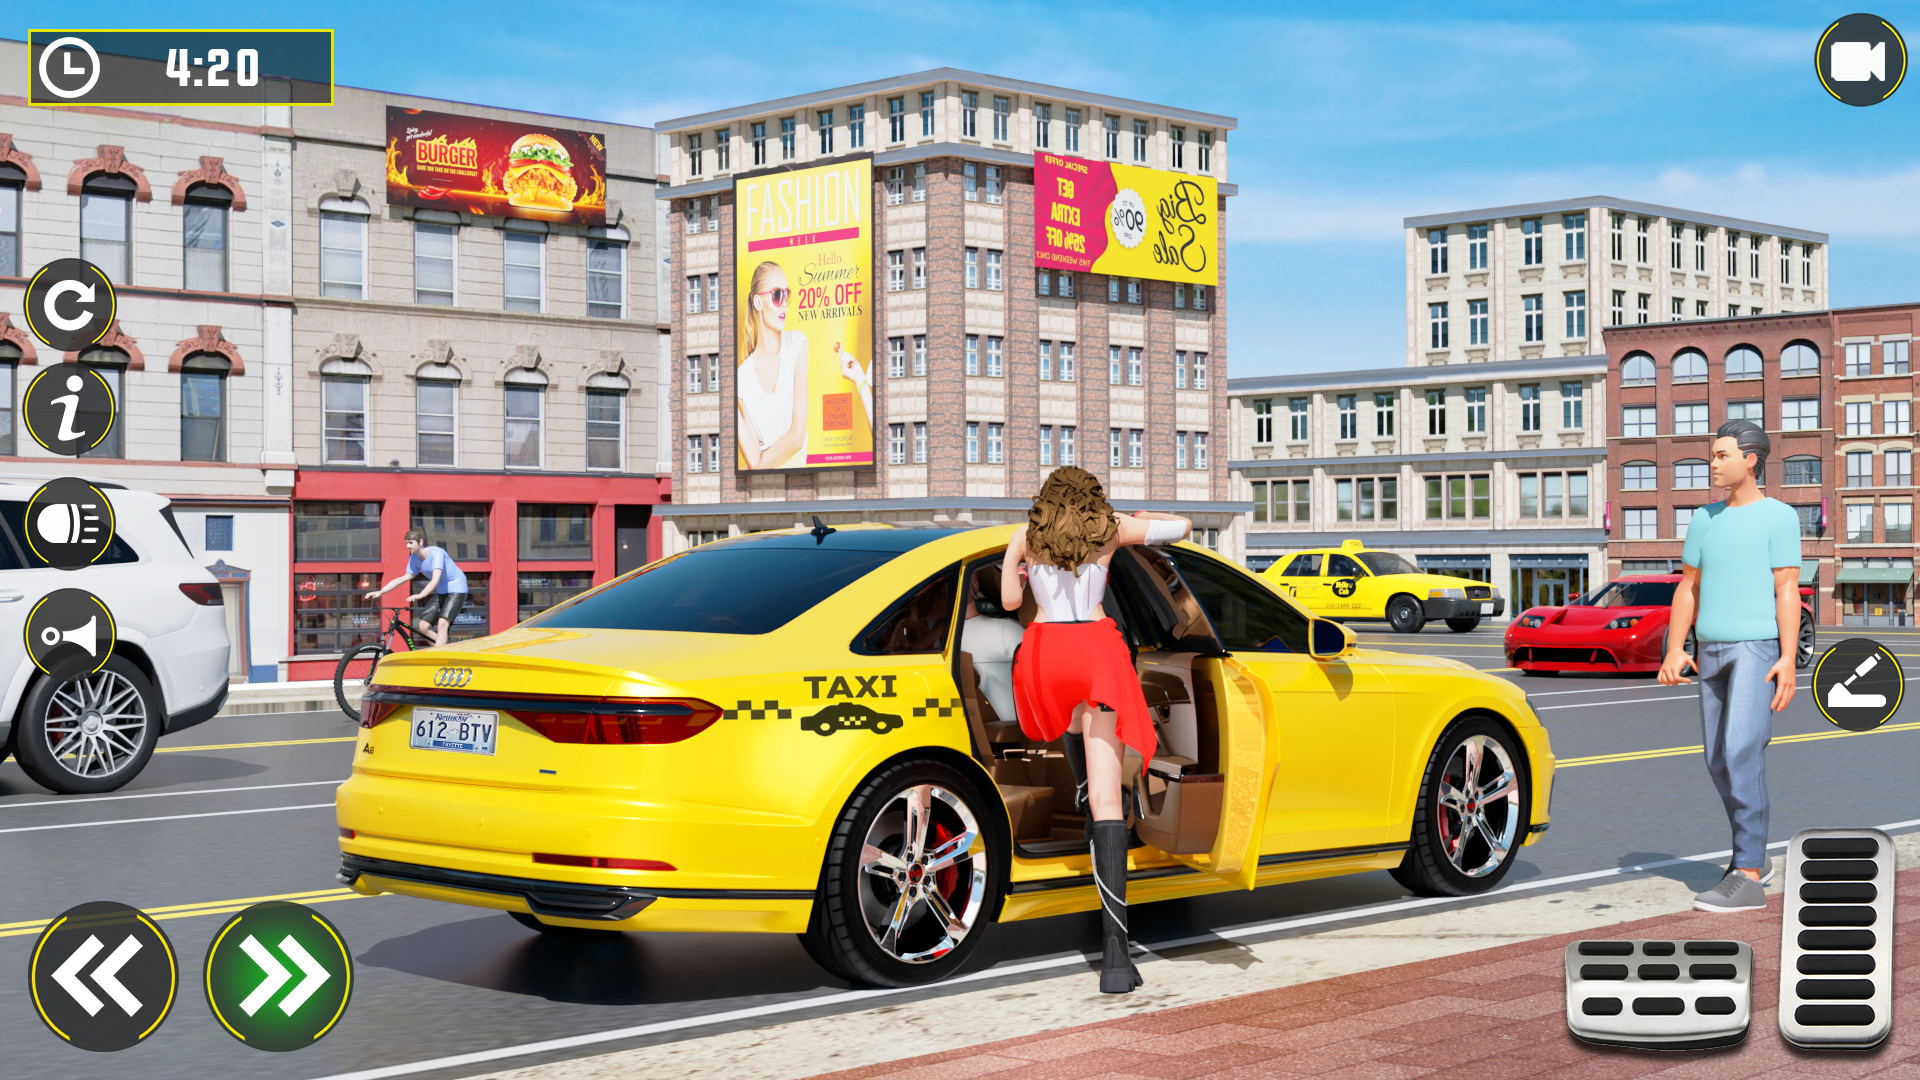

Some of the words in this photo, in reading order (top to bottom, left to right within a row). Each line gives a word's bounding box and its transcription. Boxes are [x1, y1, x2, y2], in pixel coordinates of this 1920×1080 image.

[589, 134, 604, 151] NEW
[417, 141, 477, 169] BURGER
[746, 168, 860, 238] FASHION
[789, 234, 816, 246] WEEK
[818, 251, 842, 266] Hello
[798, 262, 862, 287] Summer
[798, 285, 830, 309] 20%
[835, 282, 862, 305] OFF
[798, 309, 818, 322] NEW
[820, 304, 863, 319] ARRIVALS
[803, 675, 897, 699] TAXI
[435, 713, 468, 722] Kentucky
[416, 720, 448, 739] 612
[459, 722, 492, 743] BTV
[363, 742, 375, 755] A8
